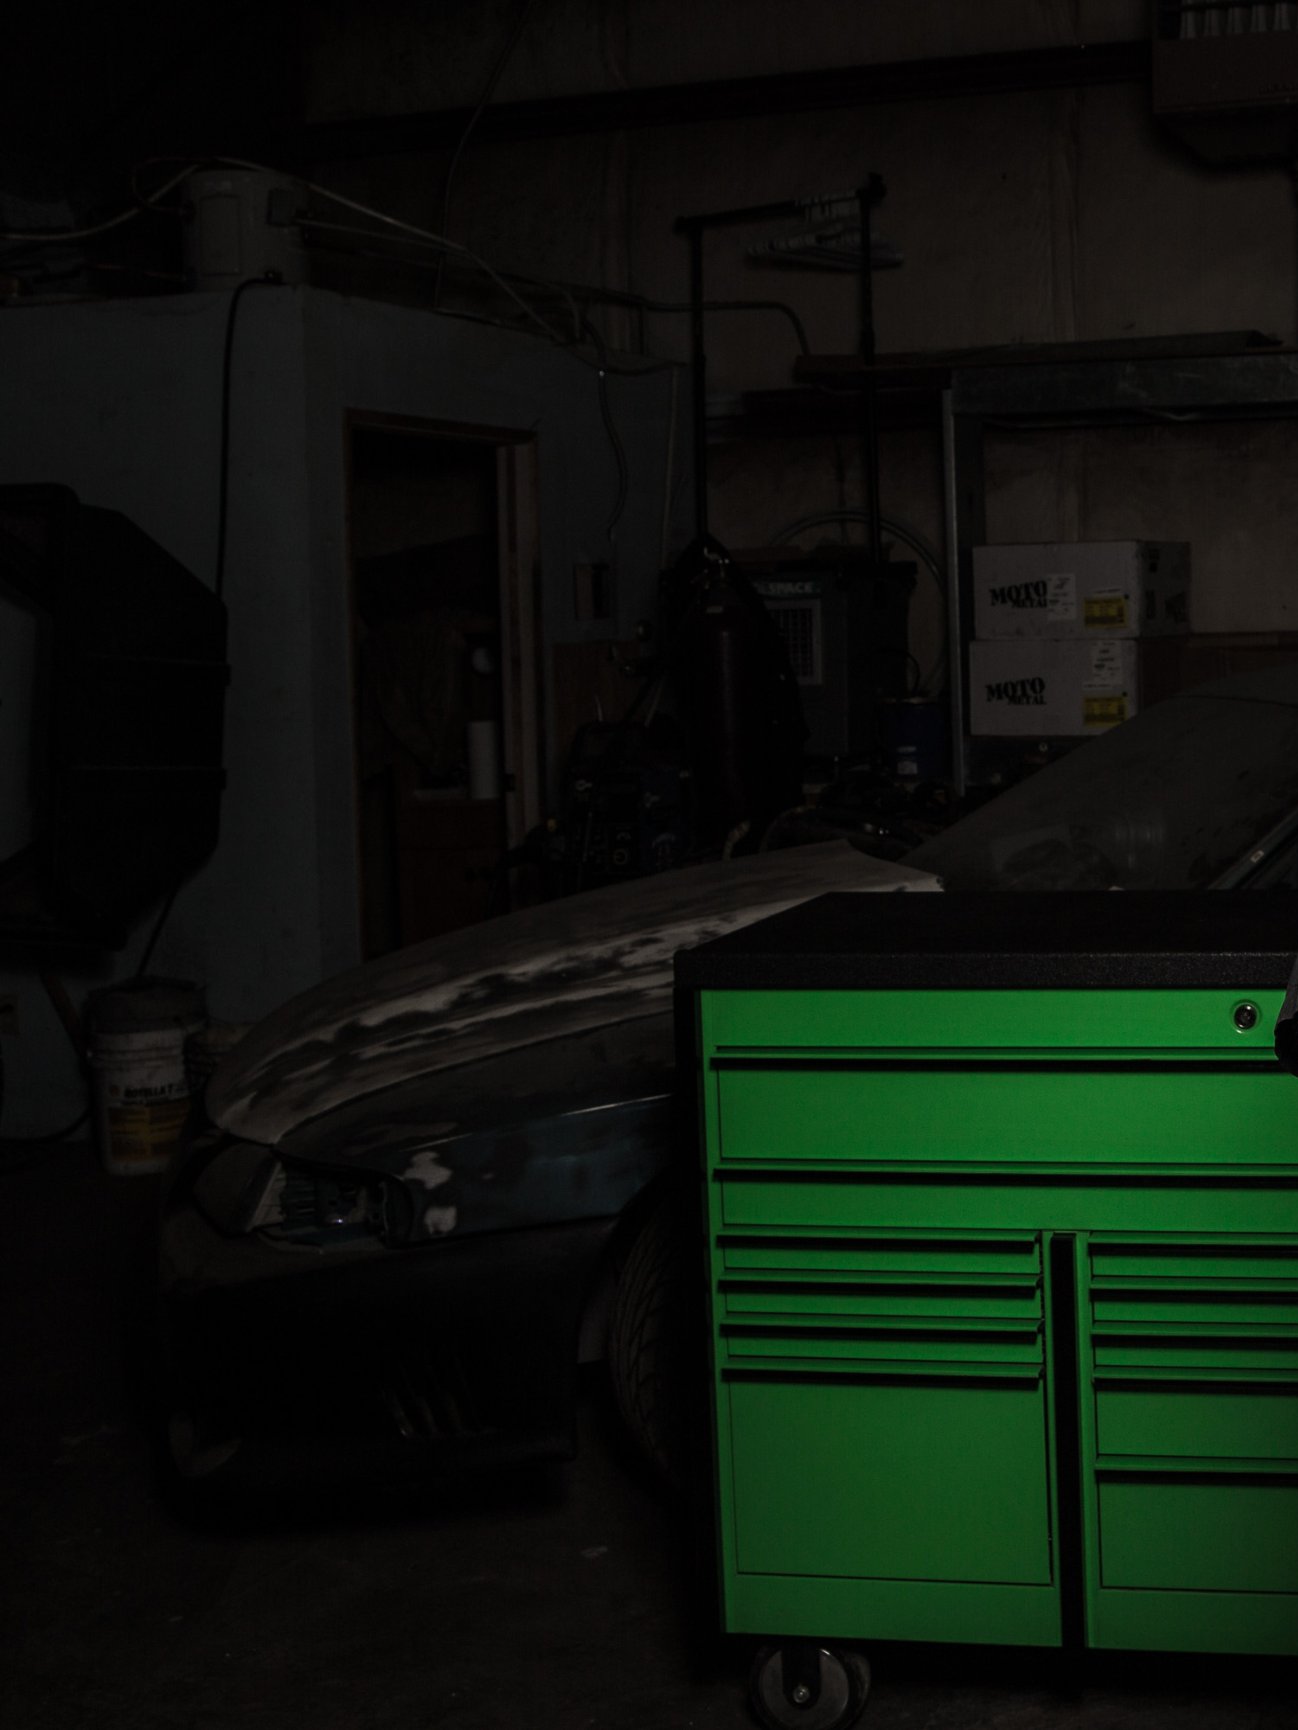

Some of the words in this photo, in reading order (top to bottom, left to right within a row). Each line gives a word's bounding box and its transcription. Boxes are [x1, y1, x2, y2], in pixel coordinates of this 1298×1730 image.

[989, 580, 1048, 606] MOTO
[984, 677, 1046, 703] MOTO
[1007, 695, 1047, 705] METAL
